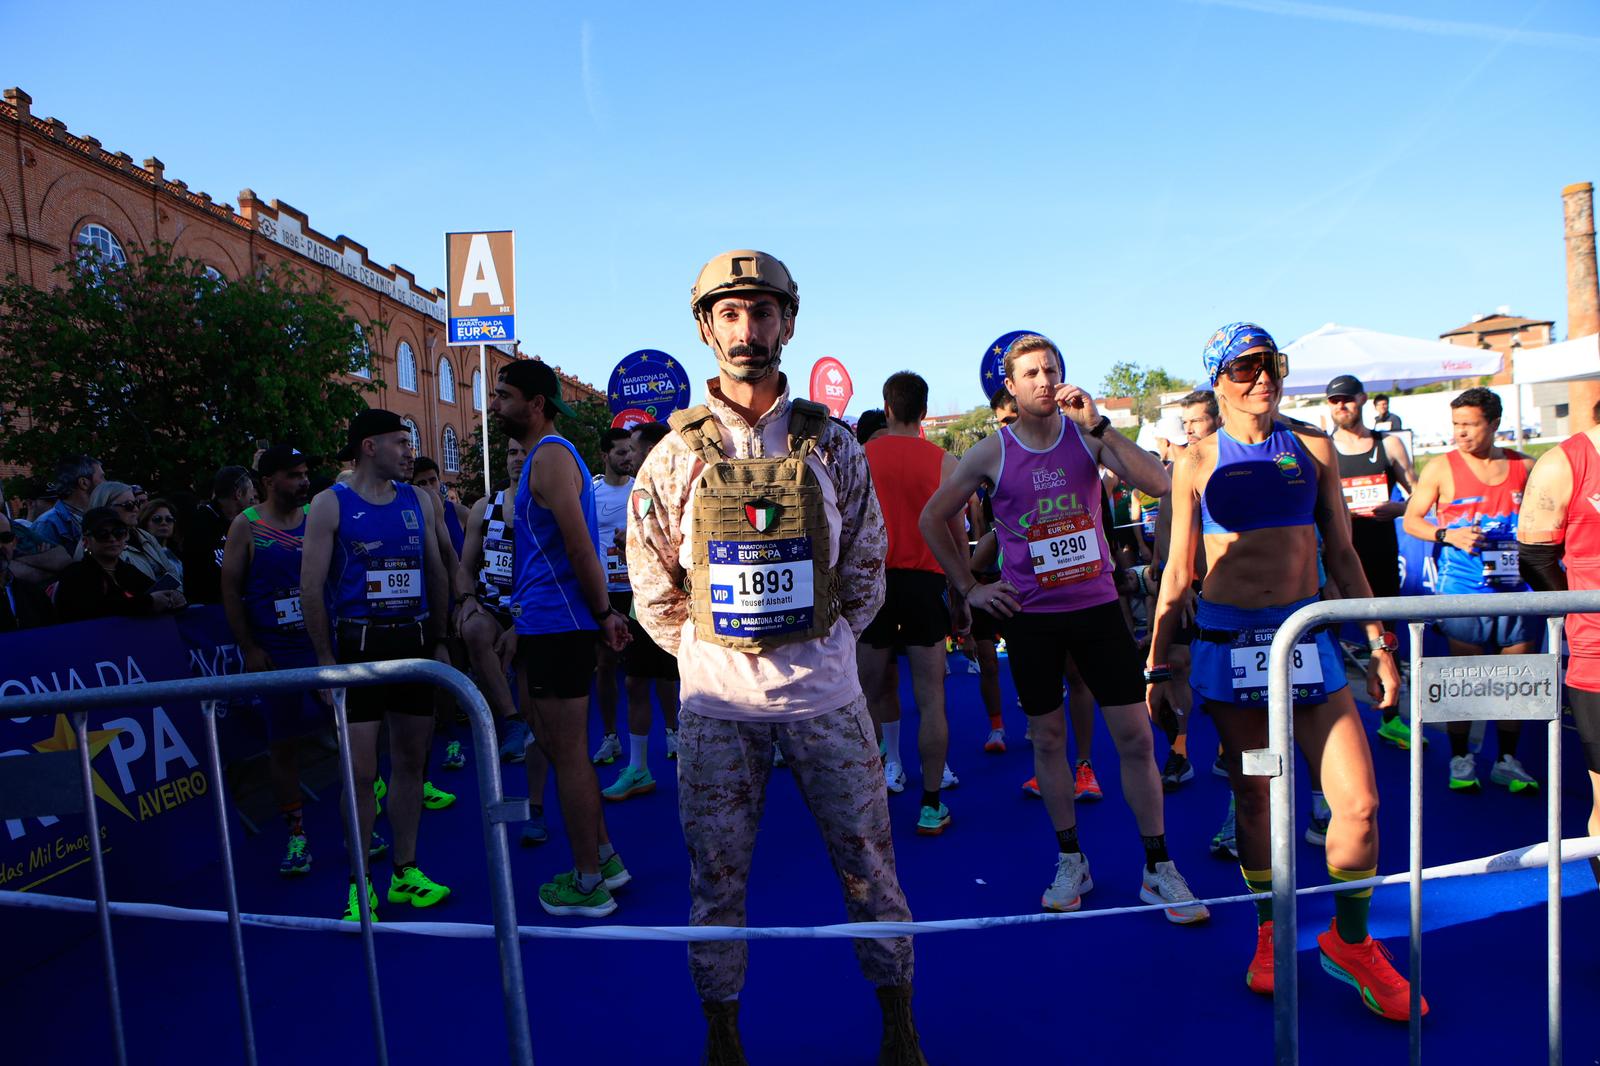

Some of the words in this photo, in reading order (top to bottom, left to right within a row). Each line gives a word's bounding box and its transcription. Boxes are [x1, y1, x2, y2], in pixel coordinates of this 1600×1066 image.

[347, 263, 358, 279] DE
[458, 233, 504, 306] A
[622, 374, 658, 384] MARATONA
[1050, 535, 1087, 557] 9290
[388, 573, 410, 588] 692
[738, 569, 794, 595] 1893
[713, 589, 729, 602] VIP
[741, 599, 765, 607] Yousef
[766, 596, 793, 606] Alshatti
[741, 617, 773, 626] MARATONA
[774, 615, 785, 623] 42K
[1255, 649, 1303, 672] 28
[1234, 667, 1245, 677] VIP
[1428, 678, 1552, 703] globalsport
[136, 771, 208, 821] AVEIRO
[29, 841, 52, 872] Mil
[56, 825, 107, 862] Emoçs
